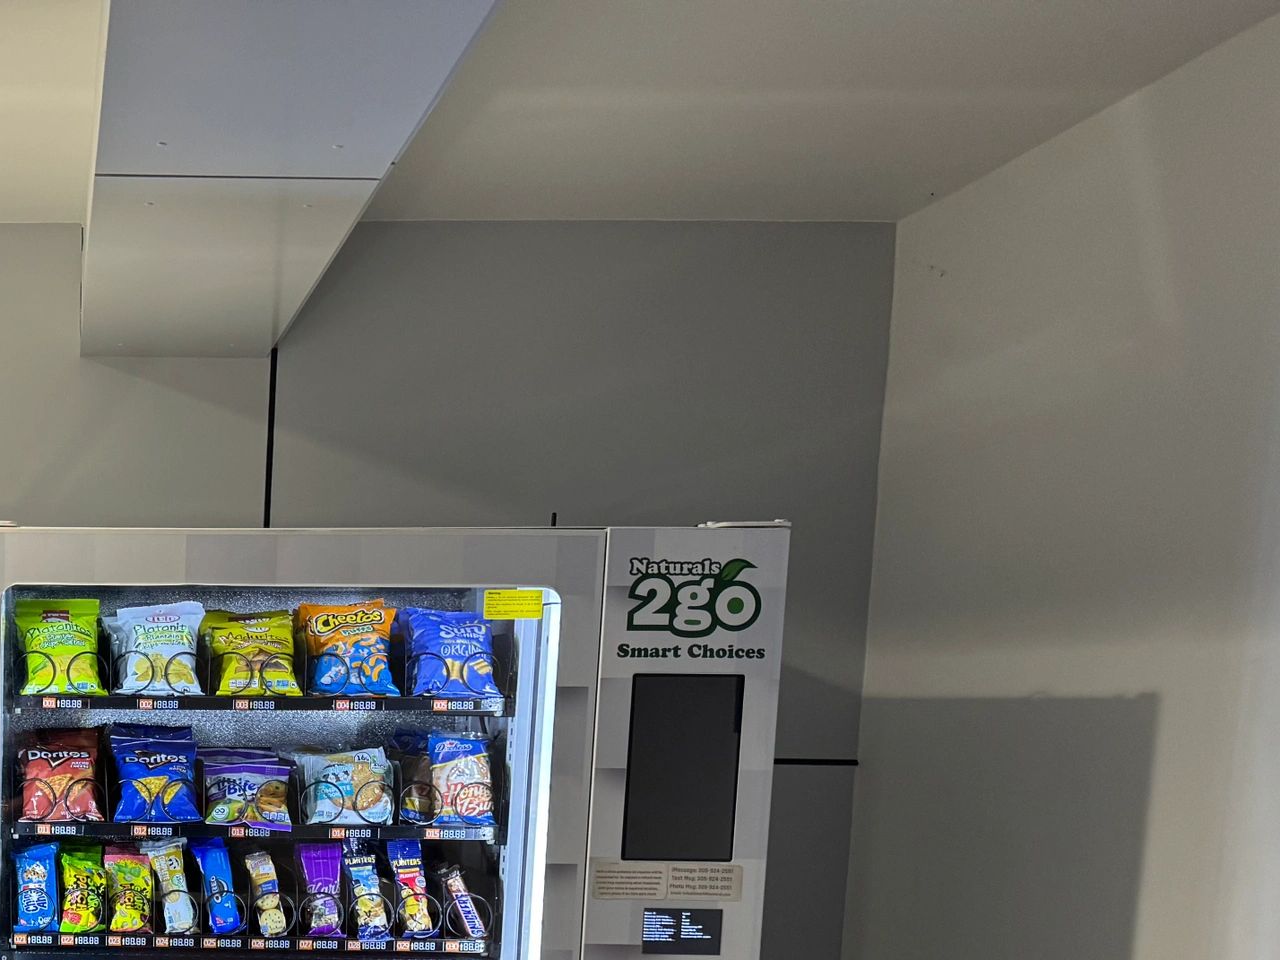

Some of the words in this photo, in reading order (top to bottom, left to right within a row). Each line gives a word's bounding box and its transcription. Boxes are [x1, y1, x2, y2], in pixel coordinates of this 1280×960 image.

[630, 557, 721, 576] Naturals
[316, 610, 383, 634] Cheetos
[616, 643, 681, 658] Smart
[687, 644, 766, 659] Choices
[140, 700, 152, 708] 002
[236, 700, 249, 709] 003
[28, 750, 90, 761] Doritos
[125, 754, 188, 765] Doritos
[232, 828, 244, 836] 013
[332, 829, 344, 838] 014
[345, 856, 376, 865] PLANTERS
[393, 858, 422, 867] PLANTERS
[453, 893, 487, 938] SNICKERS
[109, 937, 121, 946] 023
